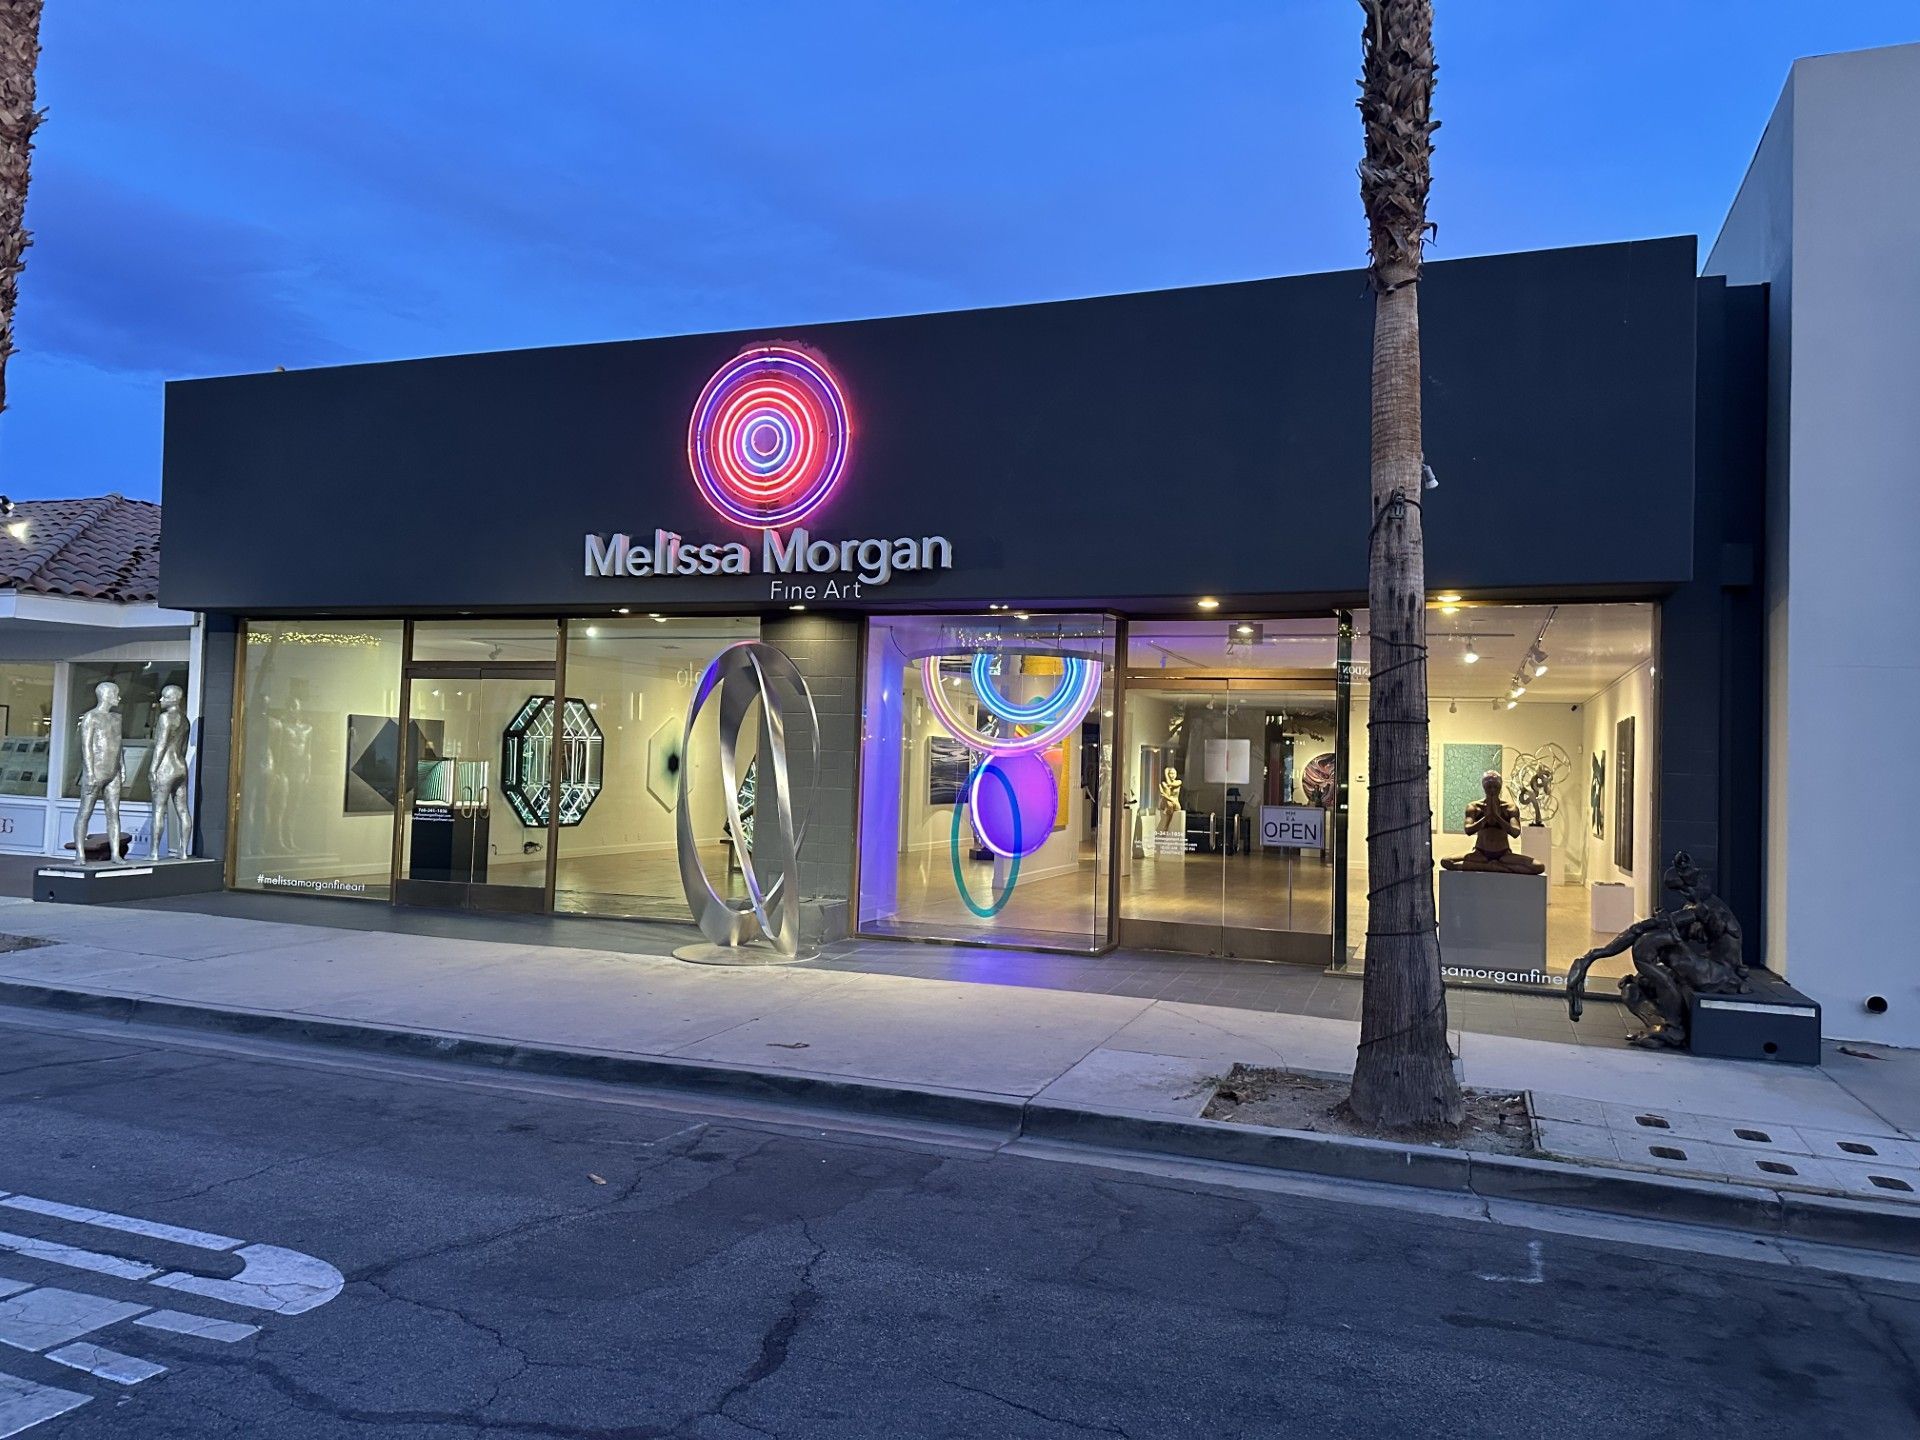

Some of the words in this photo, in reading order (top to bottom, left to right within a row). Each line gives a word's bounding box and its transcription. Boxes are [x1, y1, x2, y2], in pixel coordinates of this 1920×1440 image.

[585, 528, 750, 577] Melissa
[763, 528, 952, 585] Morgan
[770, 580, 817, 599] Fine
[823, 579, 862, 599] Art
[1264, 821, 1317, 840] OPEN
[257, 873, 365, 892] #melissamorganfineart
